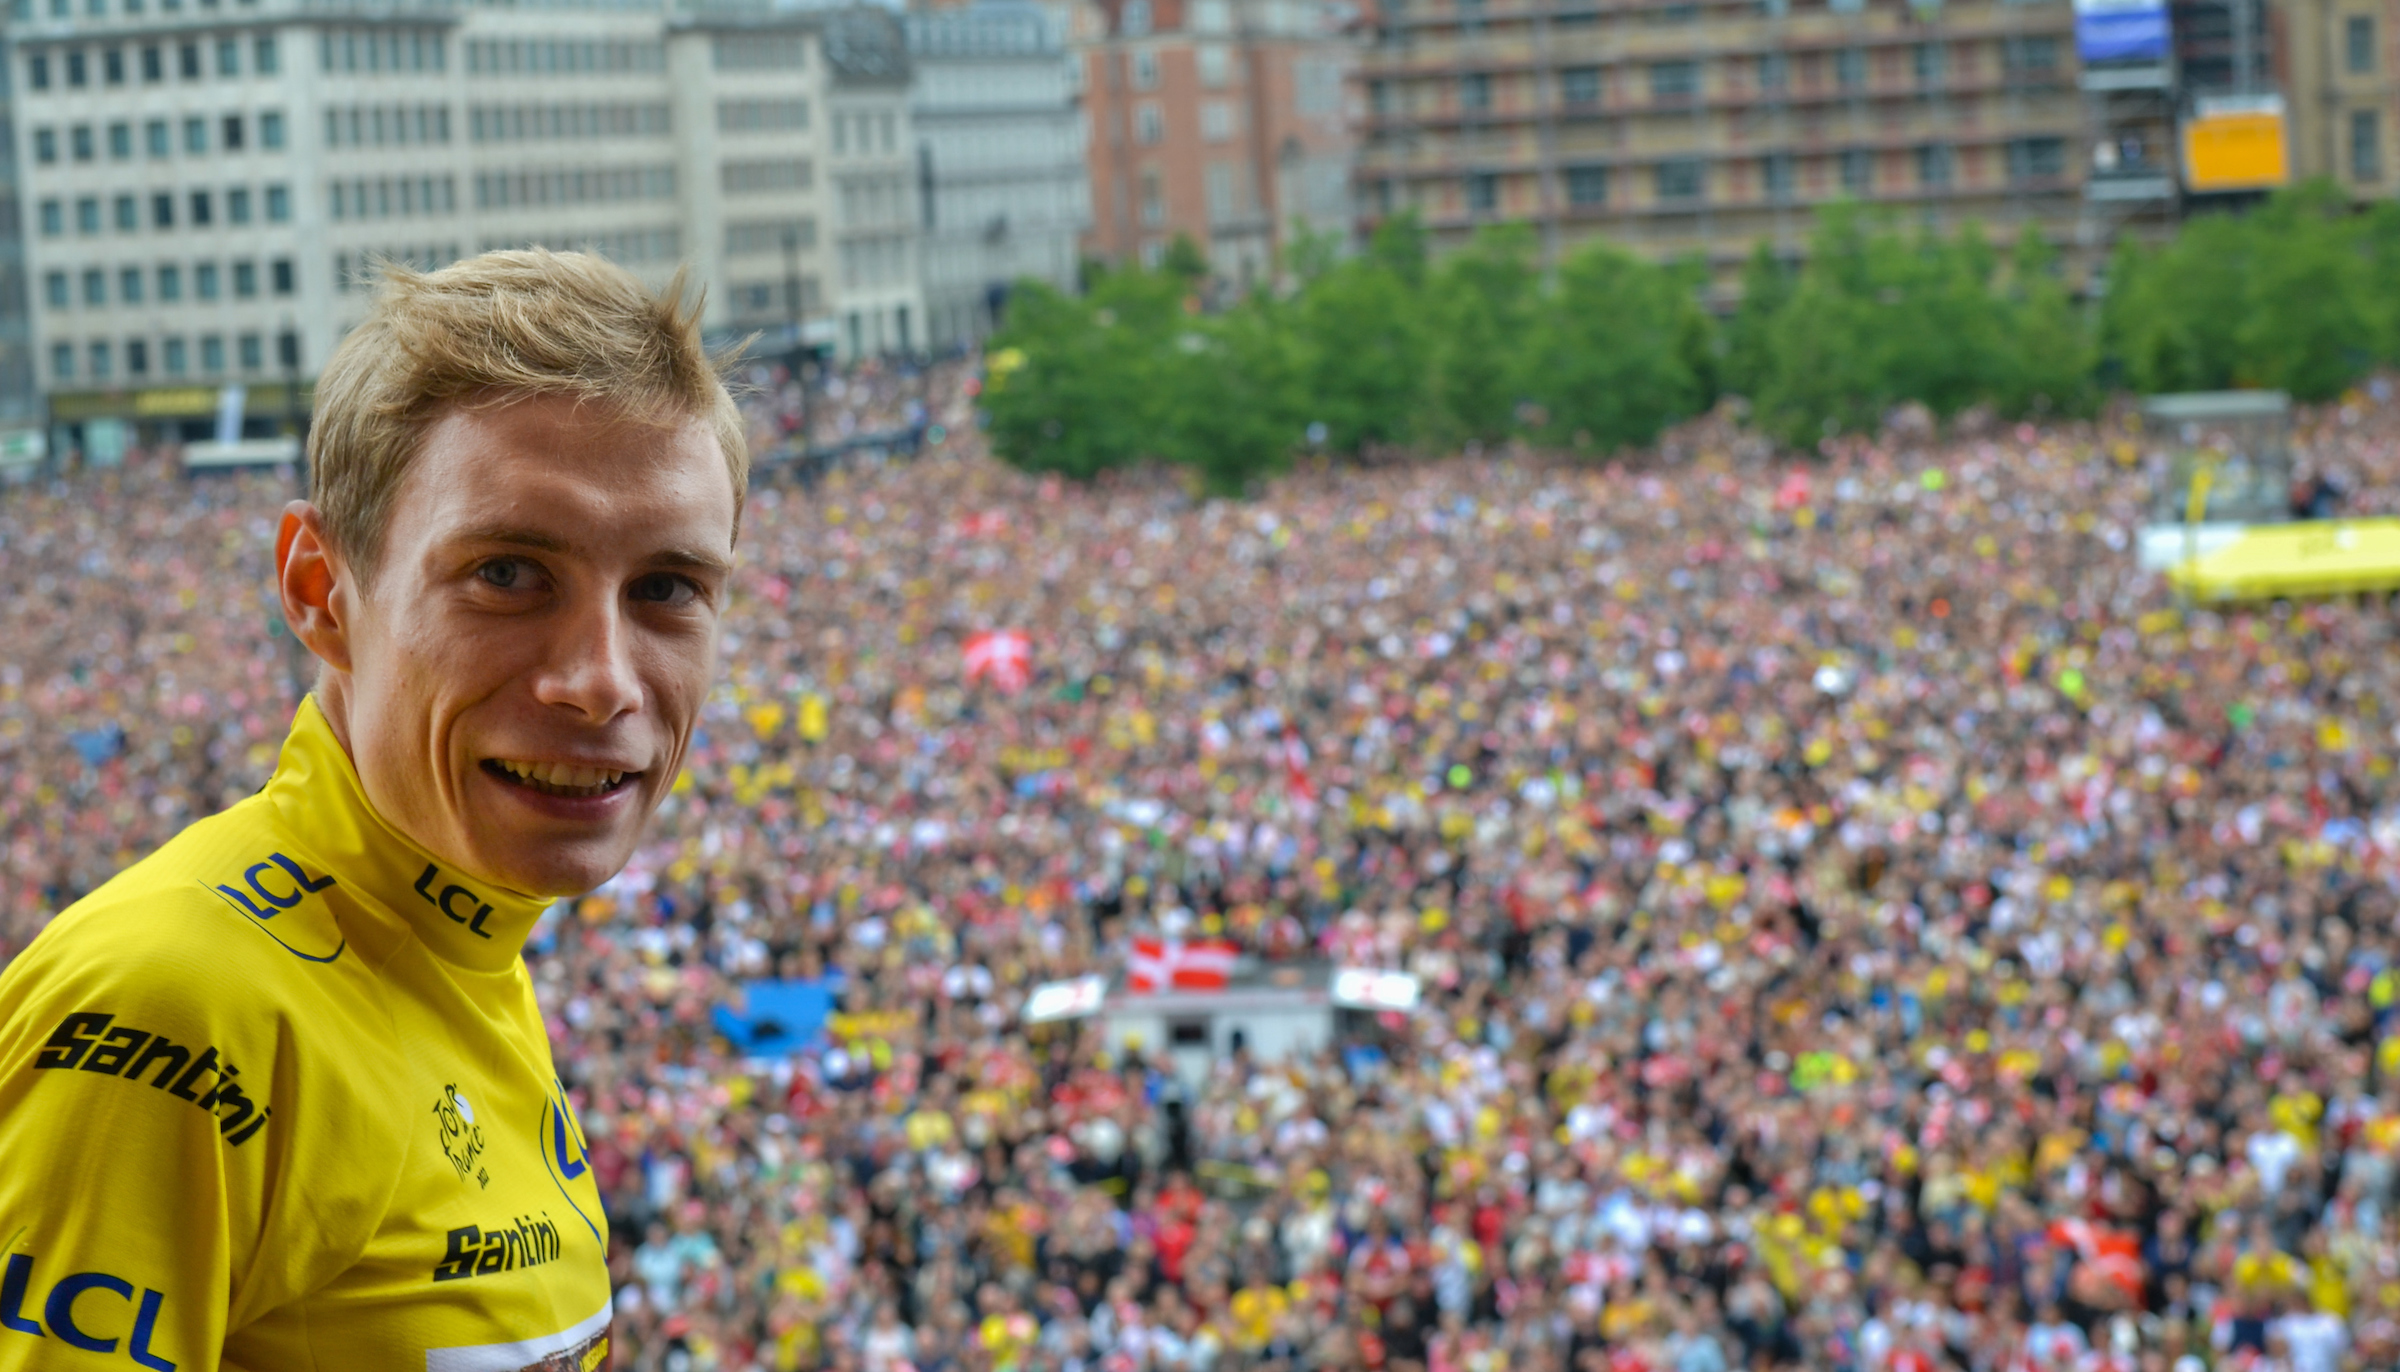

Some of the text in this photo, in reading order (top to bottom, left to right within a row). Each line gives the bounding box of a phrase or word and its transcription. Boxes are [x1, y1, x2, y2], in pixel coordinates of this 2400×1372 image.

[215, 852, 337, 920] LCL
[414, 862, 495, 940] LCL
[33, 1012, 272, 1147] Santini
[433, 1210, 560, 1282] Santini
[0, 1253, 178, 1372] LCL
